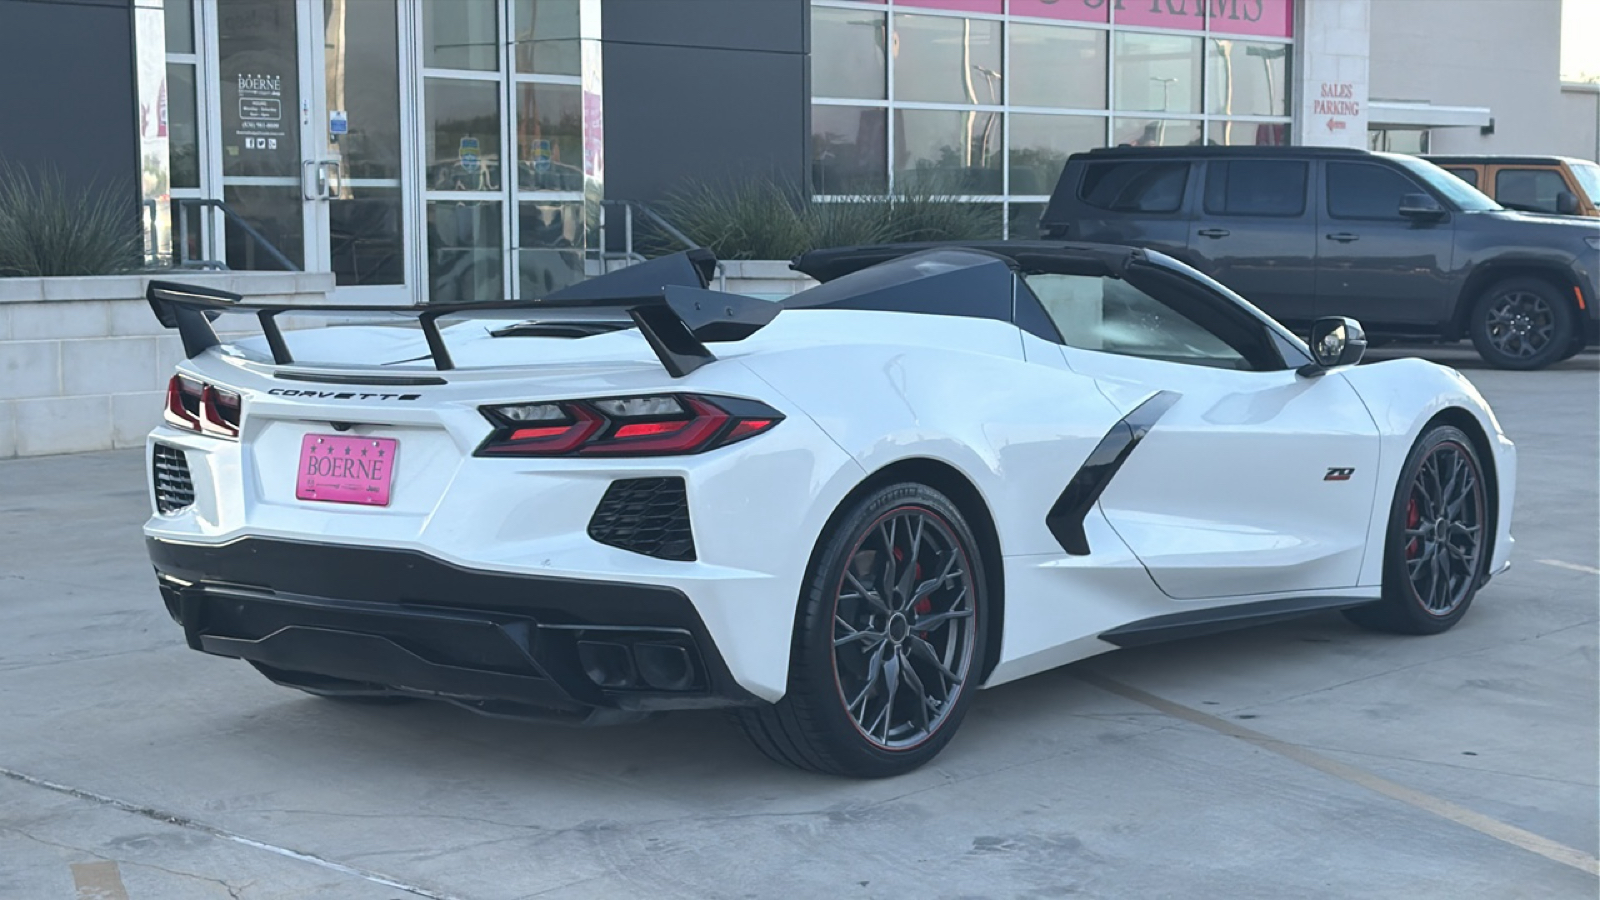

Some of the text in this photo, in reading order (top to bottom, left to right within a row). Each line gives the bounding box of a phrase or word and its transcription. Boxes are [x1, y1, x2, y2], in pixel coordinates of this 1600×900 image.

[238, 78, 281, 91] BOERNE
[1320, 83, 1353, 99] SALES
[1313, 99, 1360, 116] PARKING
[267, 388, 422, 401] CORVETTE
[306, 455, 384, 481] BOERNE
